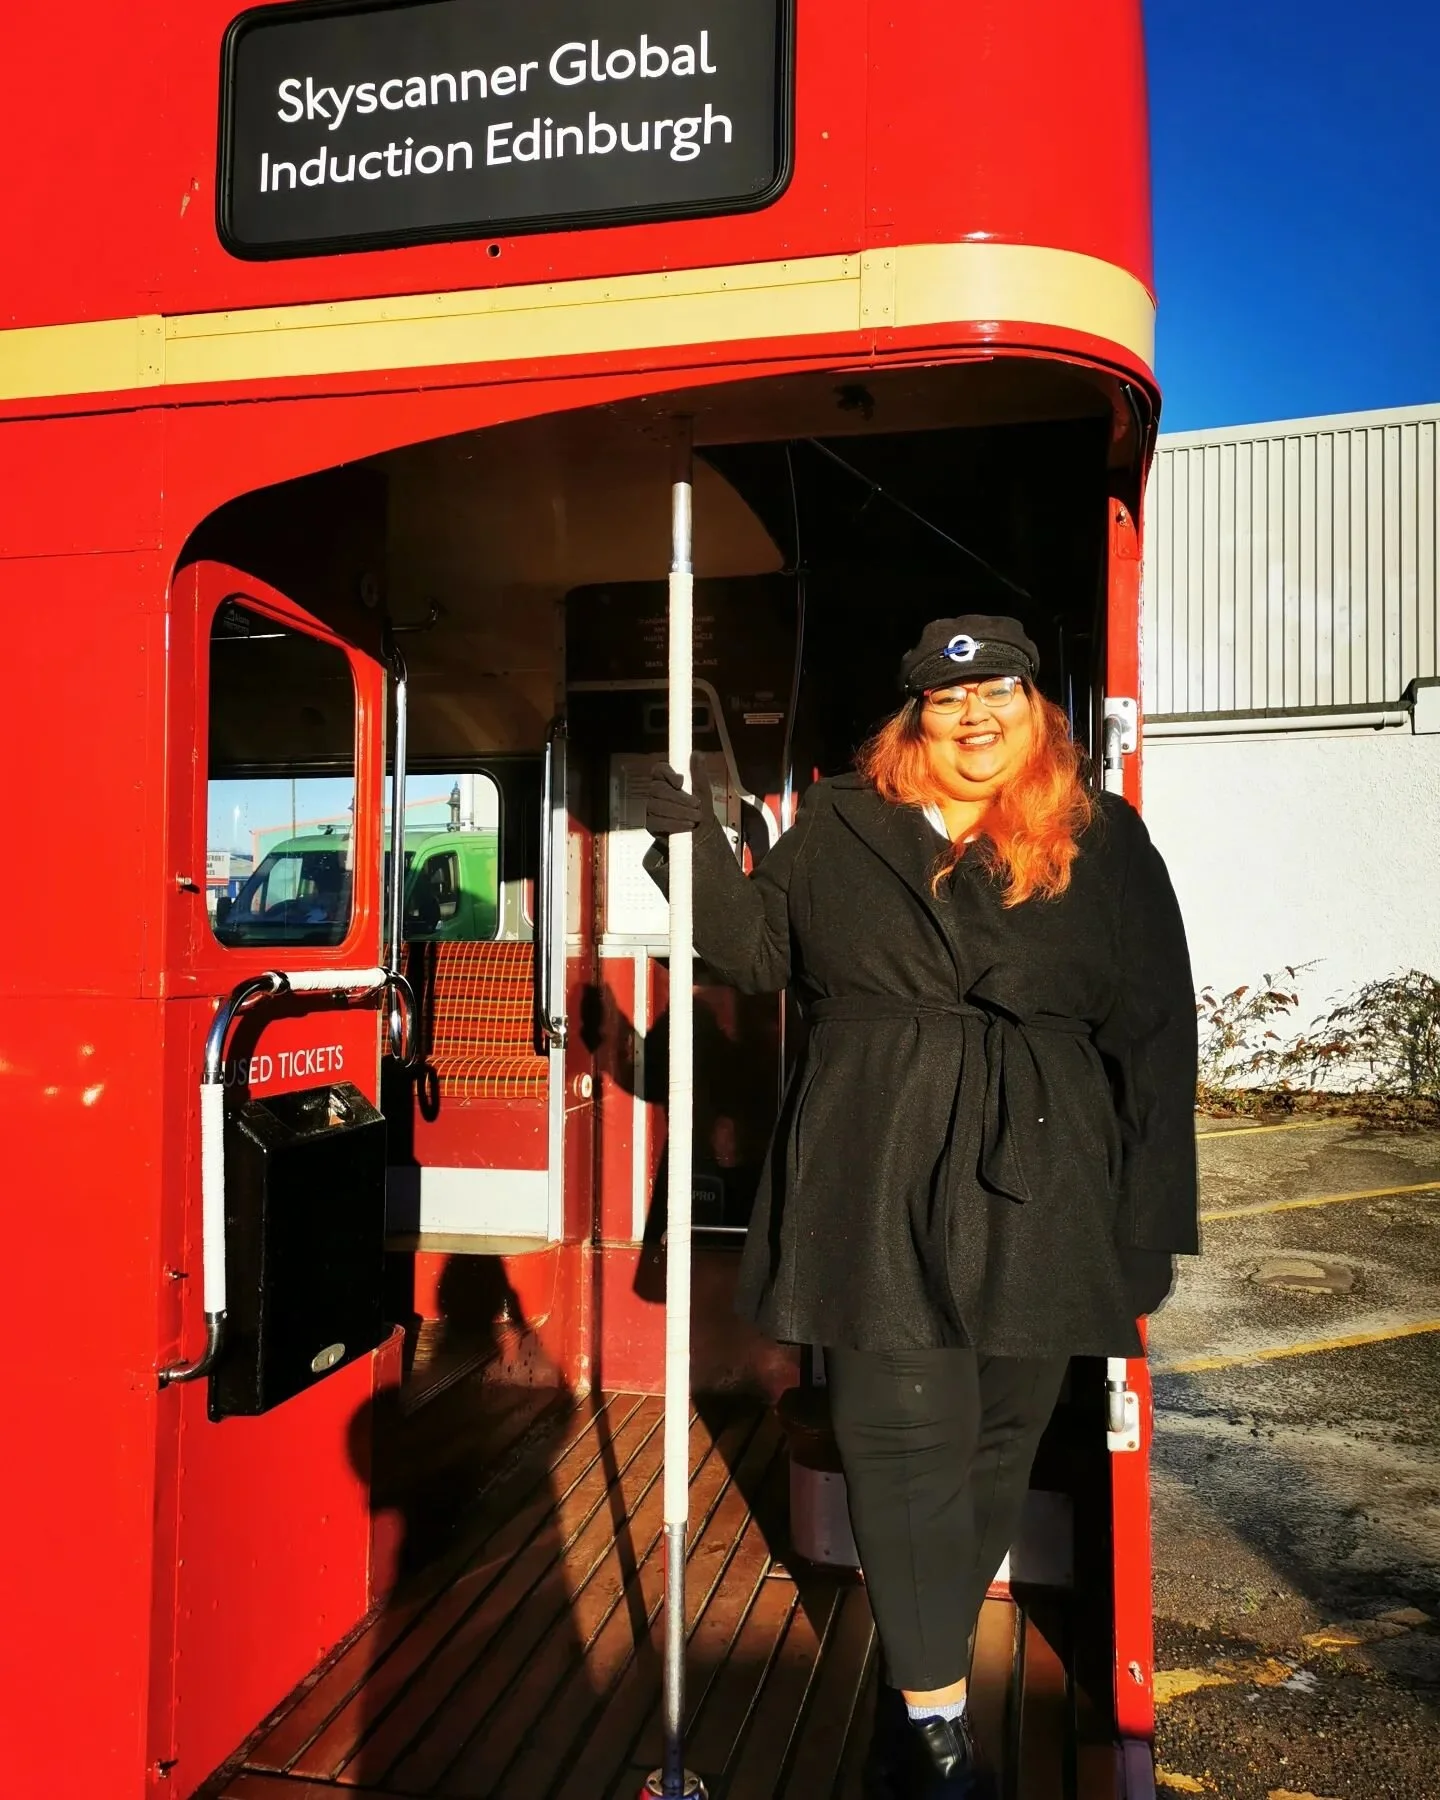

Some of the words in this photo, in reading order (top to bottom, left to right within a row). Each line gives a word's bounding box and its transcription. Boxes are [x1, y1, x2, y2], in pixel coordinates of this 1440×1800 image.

[278, 61, 538, 131] Skyscanner
[548, 30, 717, 86] Global
[260, 137, 473, 193] Induction
[486, 103, 733, 163] Edinburgh
[222, 1055, 272, 1088] USED
[278, 1045, 344, 1078] TICKETS
